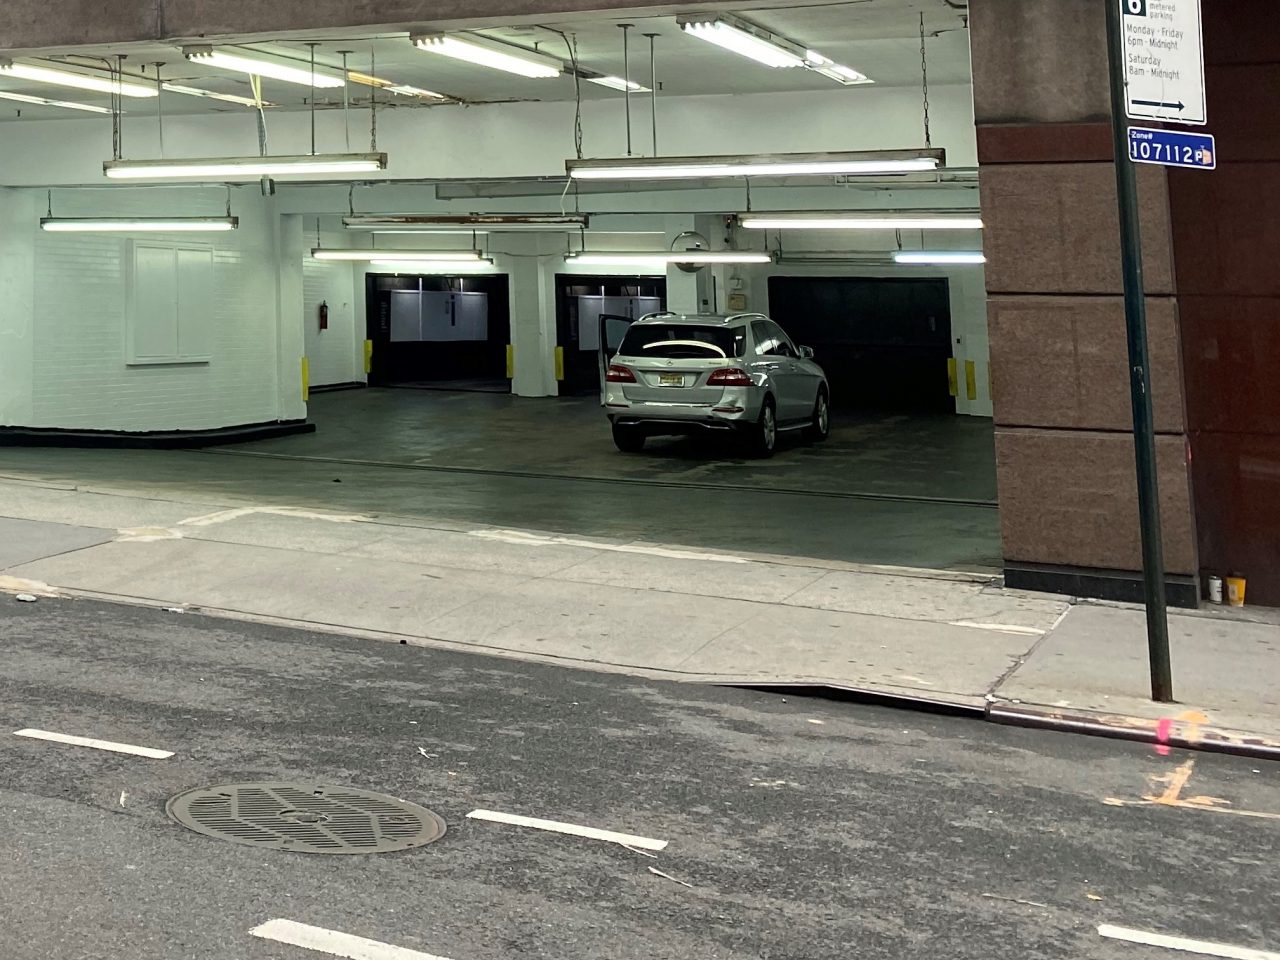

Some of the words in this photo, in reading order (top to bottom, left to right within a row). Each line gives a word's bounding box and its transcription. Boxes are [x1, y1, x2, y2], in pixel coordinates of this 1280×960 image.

[1150, 3, 1175, 11] metered
[1150, 12, 1172, 22] parking
[1127, 24, 1154, 35] Monday
[1162, 28, 1183, 41] Friday
[1128, 36, 1143, 47] 6pm
[1150, 38, 1177, 51] Midnight
[1129, 53, 1161, 66] Saturday
[1129, 66, 1144, 75] 8am
[1151, 68, 1179, 80] Midnight
[1132, 141, 1193, 163] 107112
